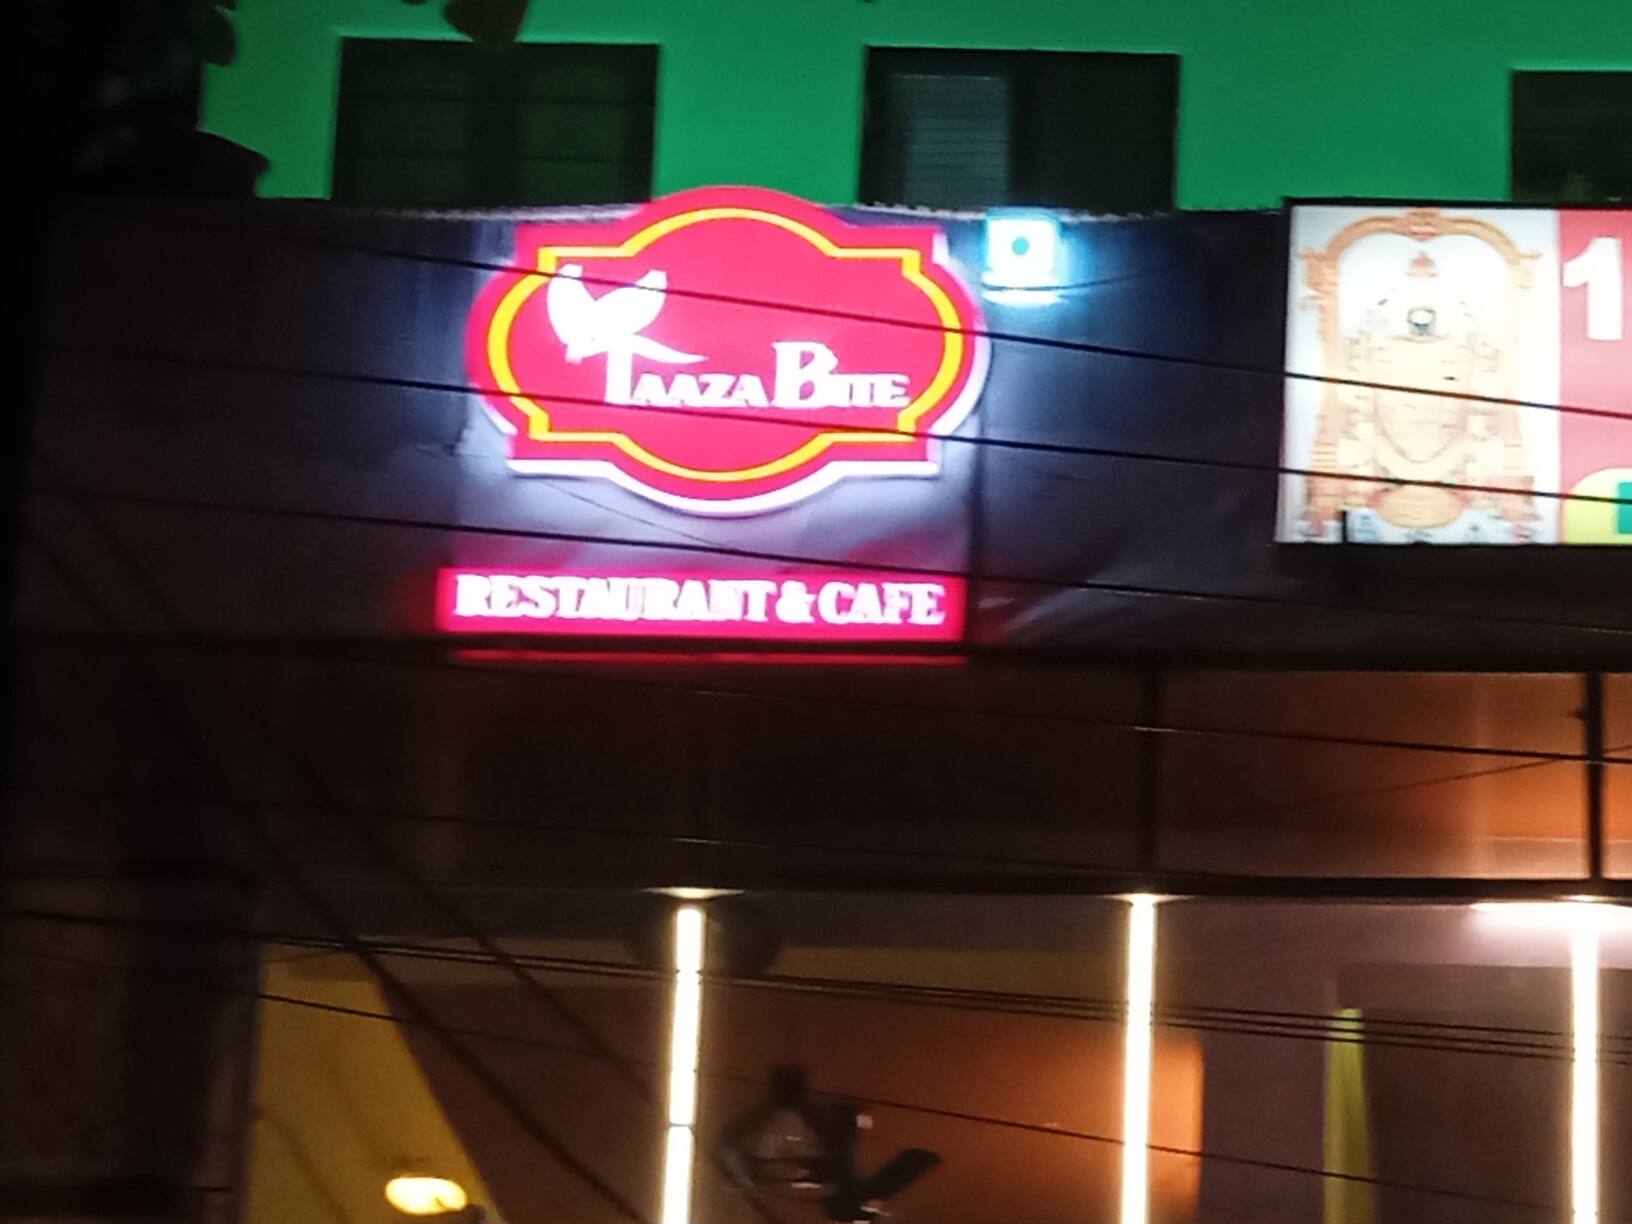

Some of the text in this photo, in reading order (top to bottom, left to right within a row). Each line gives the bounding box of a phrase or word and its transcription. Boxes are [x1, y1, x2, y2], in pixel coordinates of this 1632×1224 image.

[454, 575, 946, 625] RESTAURANT & CAFE
